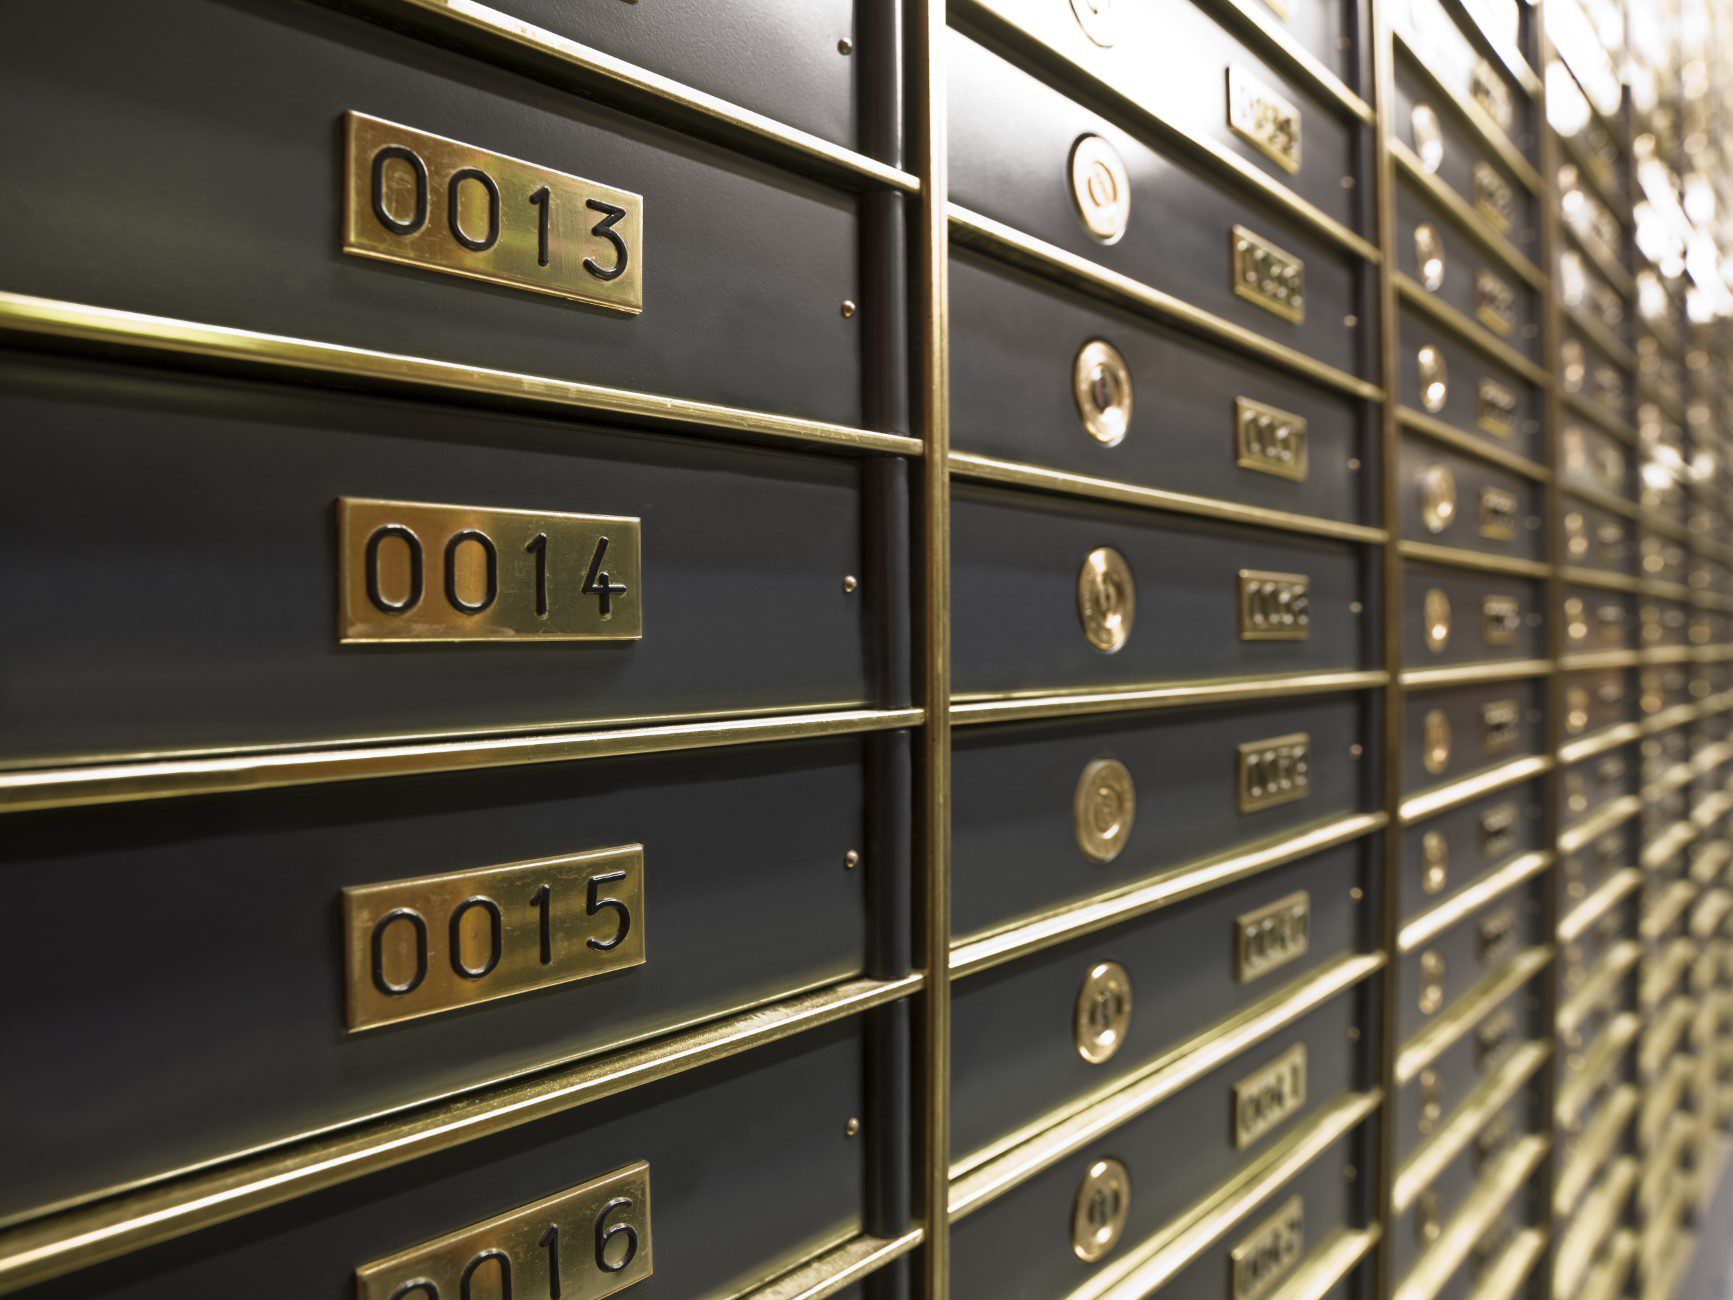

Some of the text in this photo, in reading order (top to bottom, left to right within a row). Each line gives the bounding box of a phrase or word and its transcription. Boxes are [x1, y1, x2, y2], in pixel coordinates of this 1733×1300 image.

[371, 143, 629, 281] 0013
[365, 523, 628, 621] 0014
[371, 870, 631, 997] 0015
[389, 1196, 638, 1300] 016
